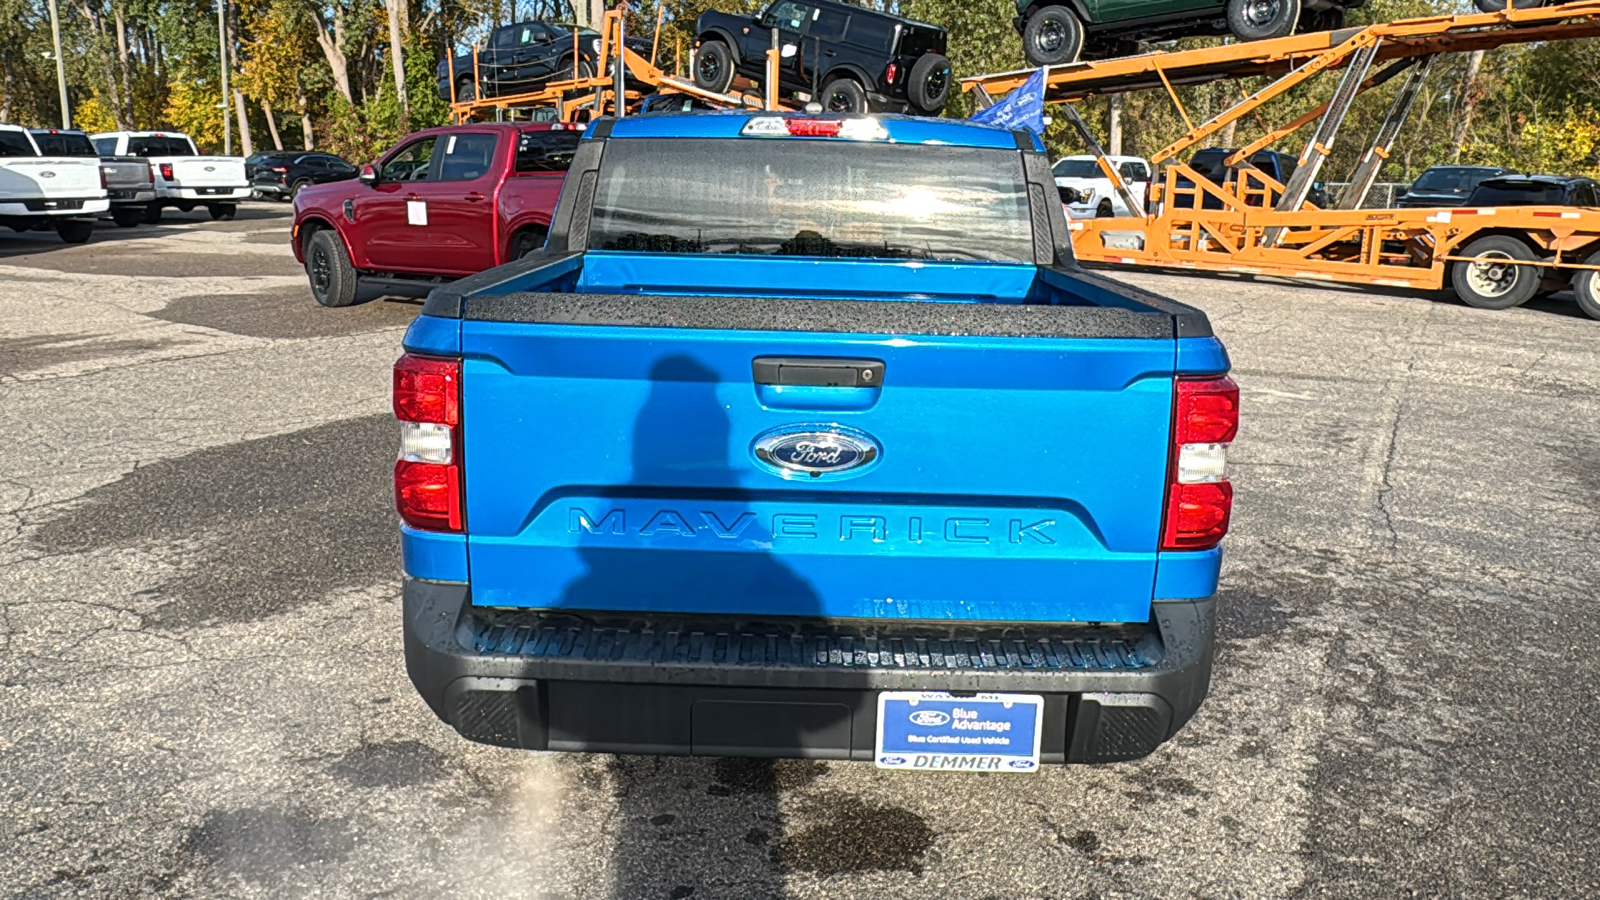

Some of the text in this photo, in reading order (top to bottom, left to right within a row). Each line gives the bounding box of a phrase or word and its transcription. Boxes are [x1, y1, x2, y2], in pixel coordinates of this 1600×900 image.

[791, 440, 843, 464] Ford
[568, 507, 1057, 545] MAVERICK
[916, 711, 943, 724] Ford
[952, 707, 979, 719] Blue
[951, 719, 1011, 732] Advantage
[907, 734, 1011, 745] Blue Certified Used Vehicle
[913, 755, 1002, 769] DEMMER
